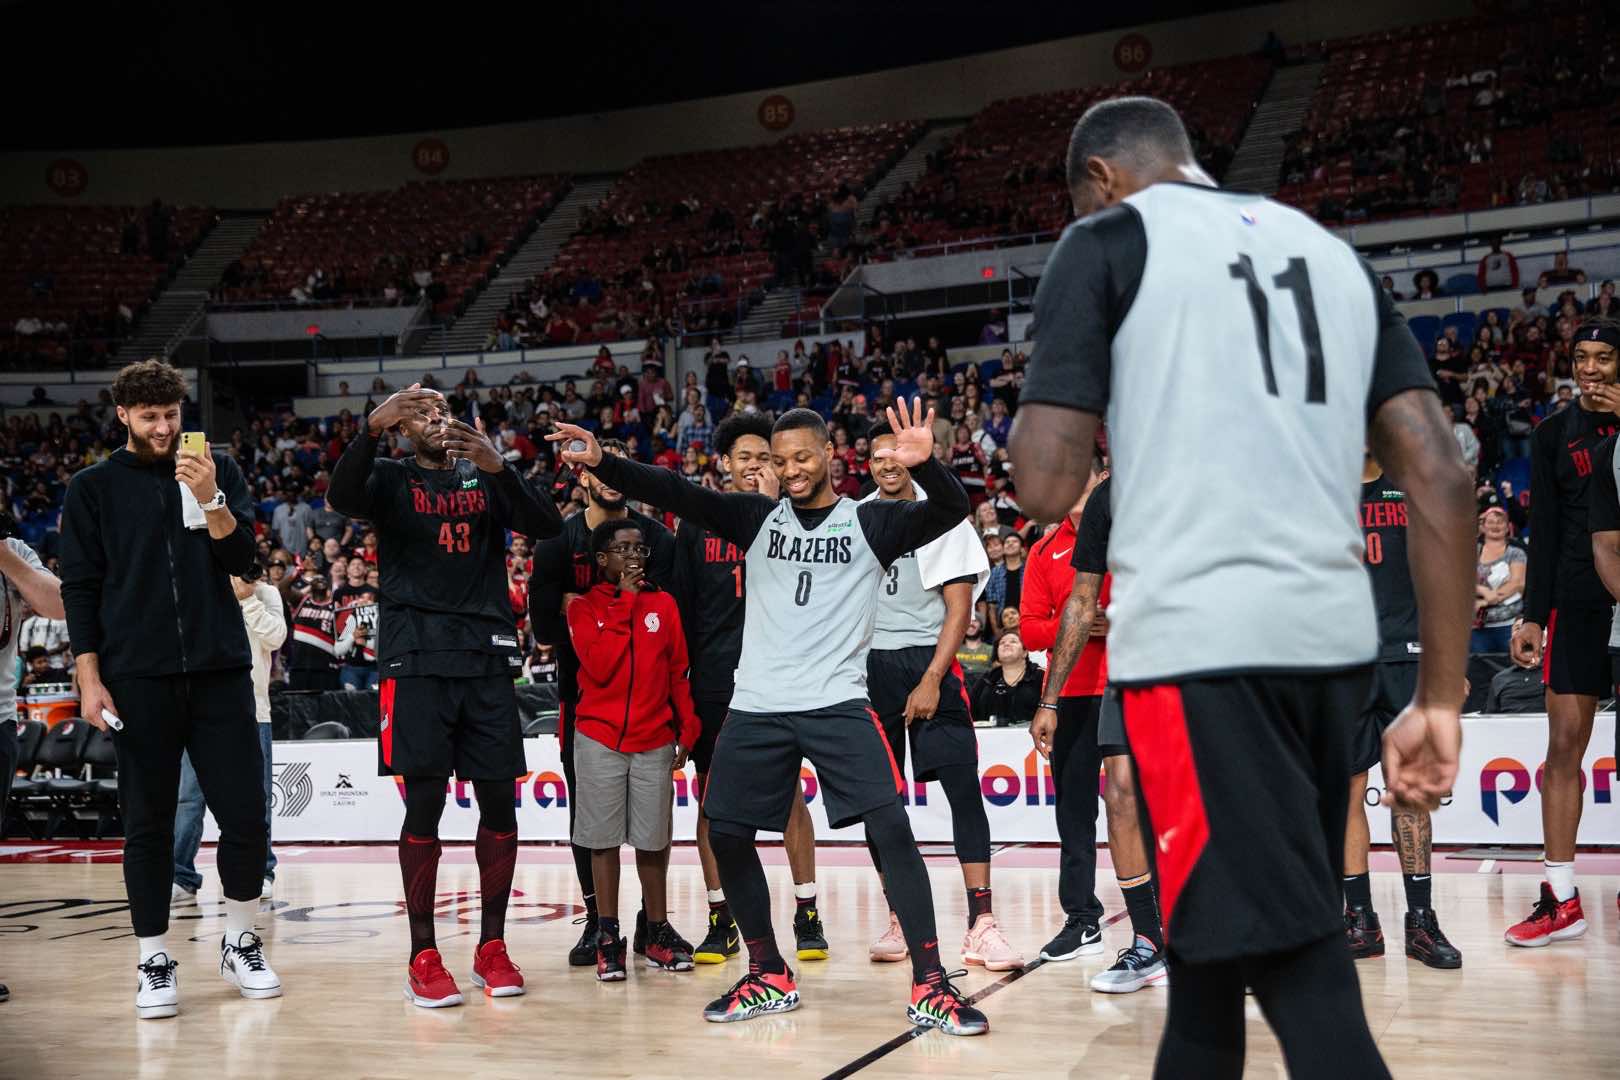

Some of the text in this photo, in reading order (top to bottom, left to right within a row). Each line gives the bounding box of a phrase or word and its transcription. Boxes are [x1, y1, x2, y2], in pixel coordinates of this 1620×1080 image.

[763, 104, 790, 123] 85
[1228, 252, 1327, 404] 11
[409, 487, 488, 517] BLAZERS
[438, 521, 472, 553] 43
[767, 529, 852, 563] BLAZERS
[794, 570, 813, 606] 0
[886, 565, 899, 596] 3
